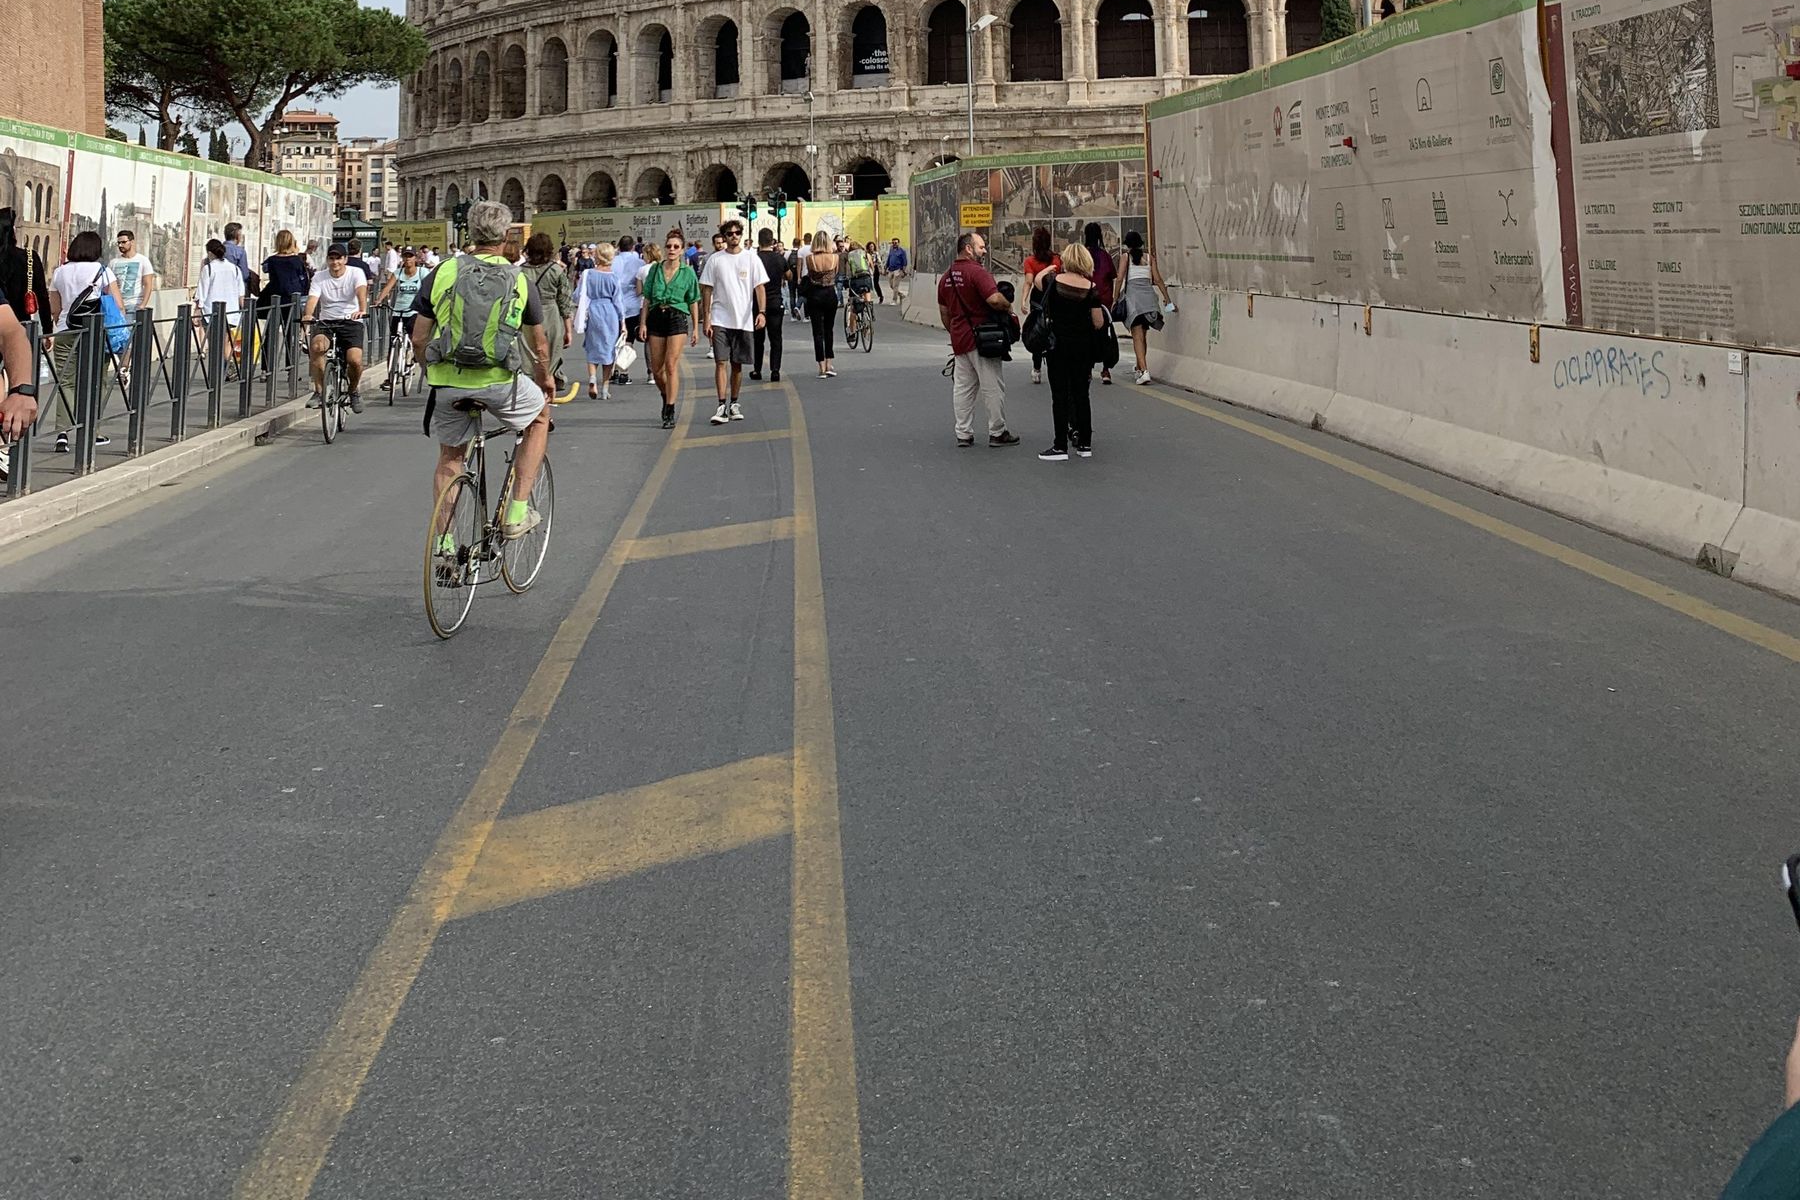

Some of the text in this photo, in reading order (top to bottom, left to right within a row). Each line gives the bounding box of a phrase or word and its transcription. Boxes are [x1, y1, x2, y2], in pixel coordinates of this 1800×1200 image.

[1576, 4, 1600, 19] TRACCIATO
[1397, 18, 1420, 38] ROMA
[1315, 105, 1330, 120] MONTE
[1495, 114, 1512, 129] Pozzi
[1324, 123, 1345, 138] PANTANO
[1106, 149, 1116, 158] VIA
[1321, 155, 1330, 169] FORI
[1591, 203, 1609, 215] TRATTA
[1652, 201, 1683, 213] SECTION T3
[1739, 204, 1766, 217] SEZIONE
[1741, 222, 1787, 235] LONGITUDINAL
[1493, 250, 1534, 266] 3 interscambi
[1588, 260, 1617, 271] LE GALLERIE
[1657, 261, 1682, 273] TUNNELS
[1568, 263, 1579, 317] ROMA
[1553, 347, 1671, 399] CICLOPIRATES
